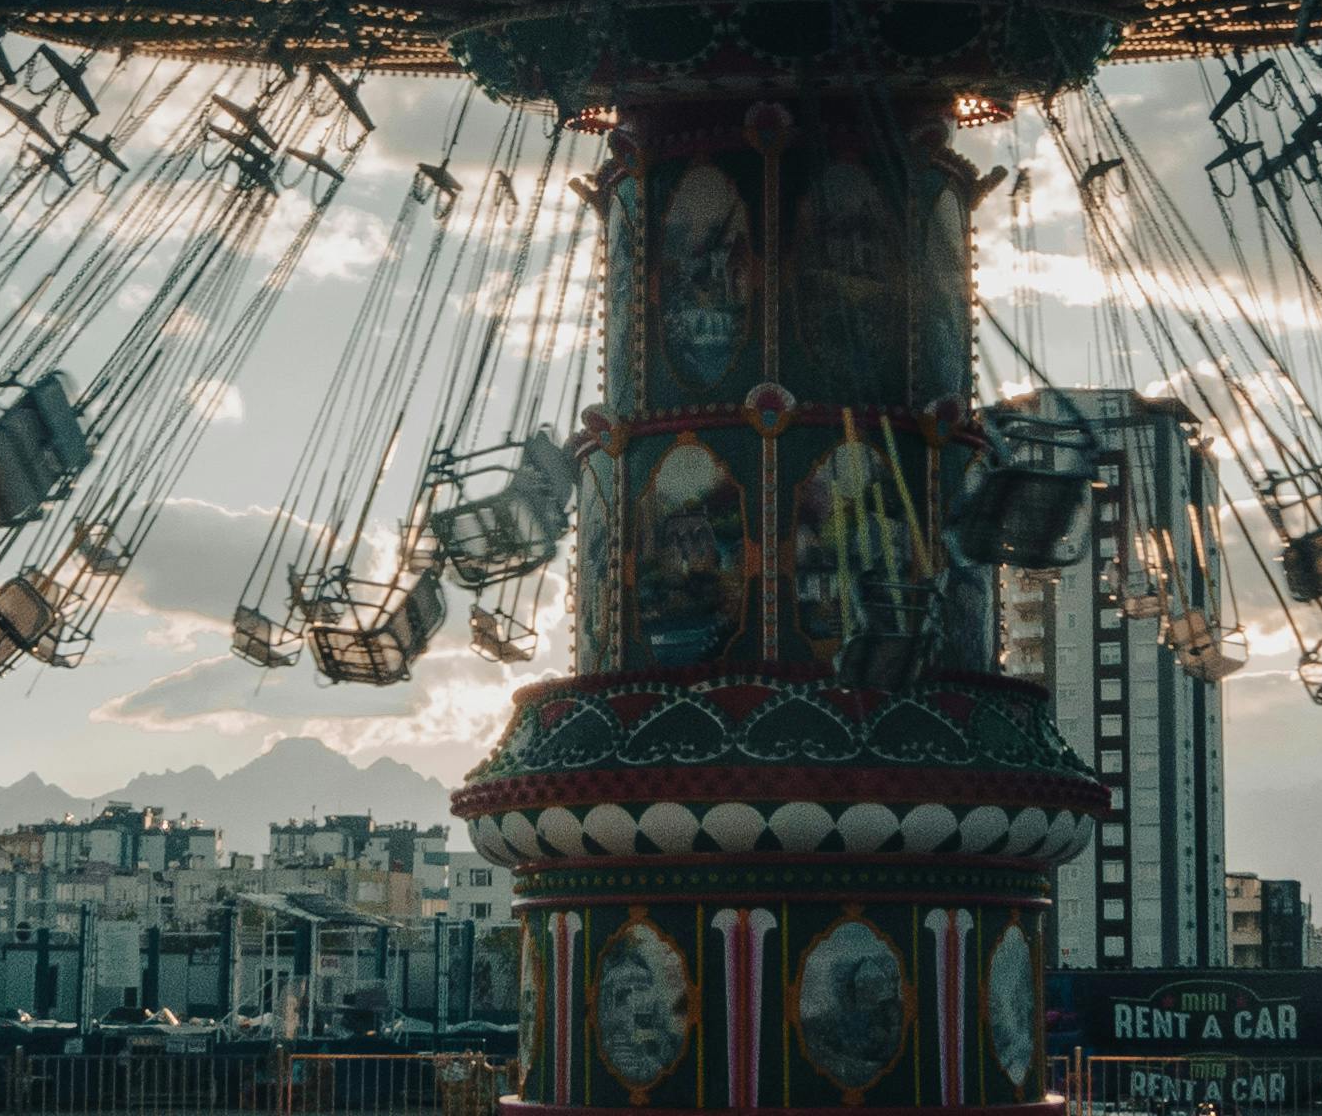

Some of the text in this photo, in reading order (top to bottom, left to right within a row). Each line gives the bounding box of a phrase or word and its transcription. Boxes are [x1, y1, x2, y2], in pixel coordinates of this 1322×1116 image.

[1114, 1004, 1297, 1039] RENT A CAR
[1231, 1073, 1285, 1102] CAR
